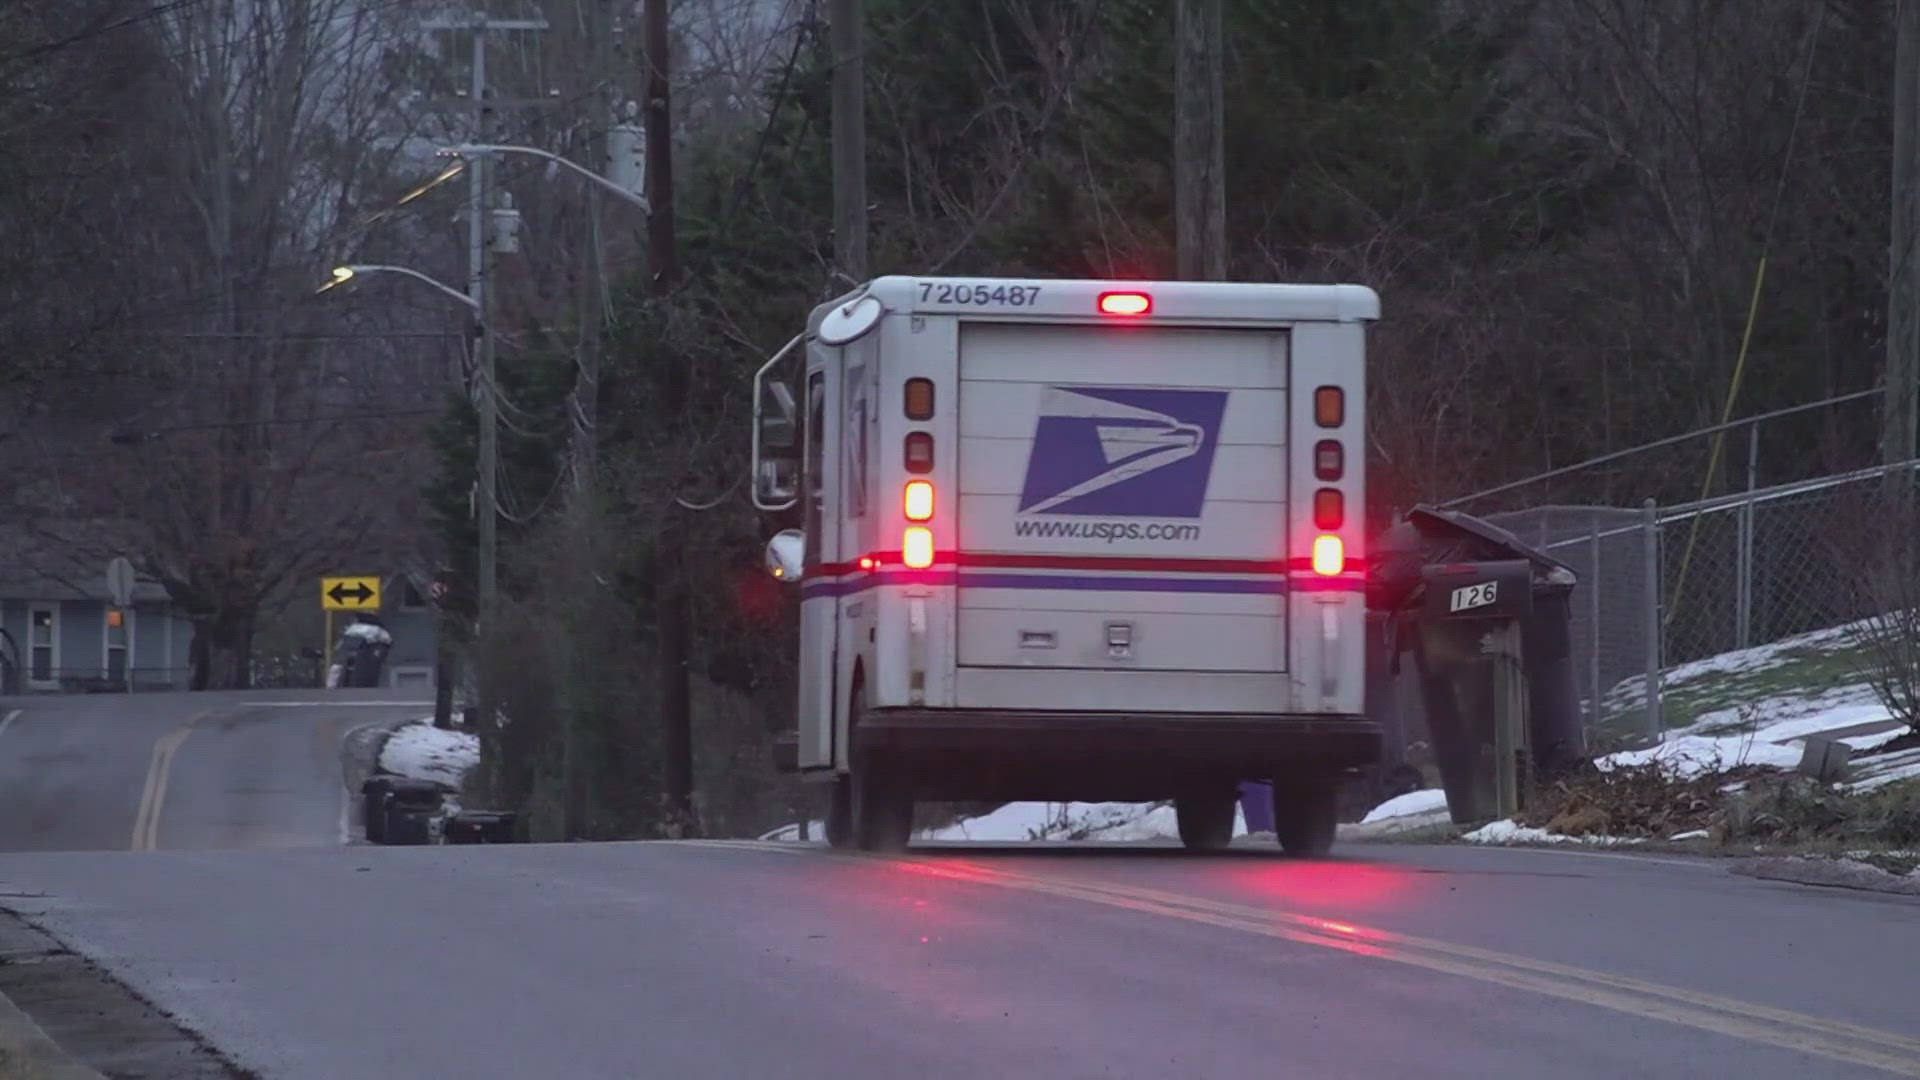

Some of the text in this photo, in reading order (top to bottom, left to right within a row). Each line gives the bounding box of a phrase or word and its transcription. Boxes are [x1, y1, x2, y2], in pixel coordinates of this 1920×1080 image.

[919, 282, 1041, 306] 7205487
[1015, 520, 1201, 543] www.usps.com
[1456, 584, 1495, 608] 126
